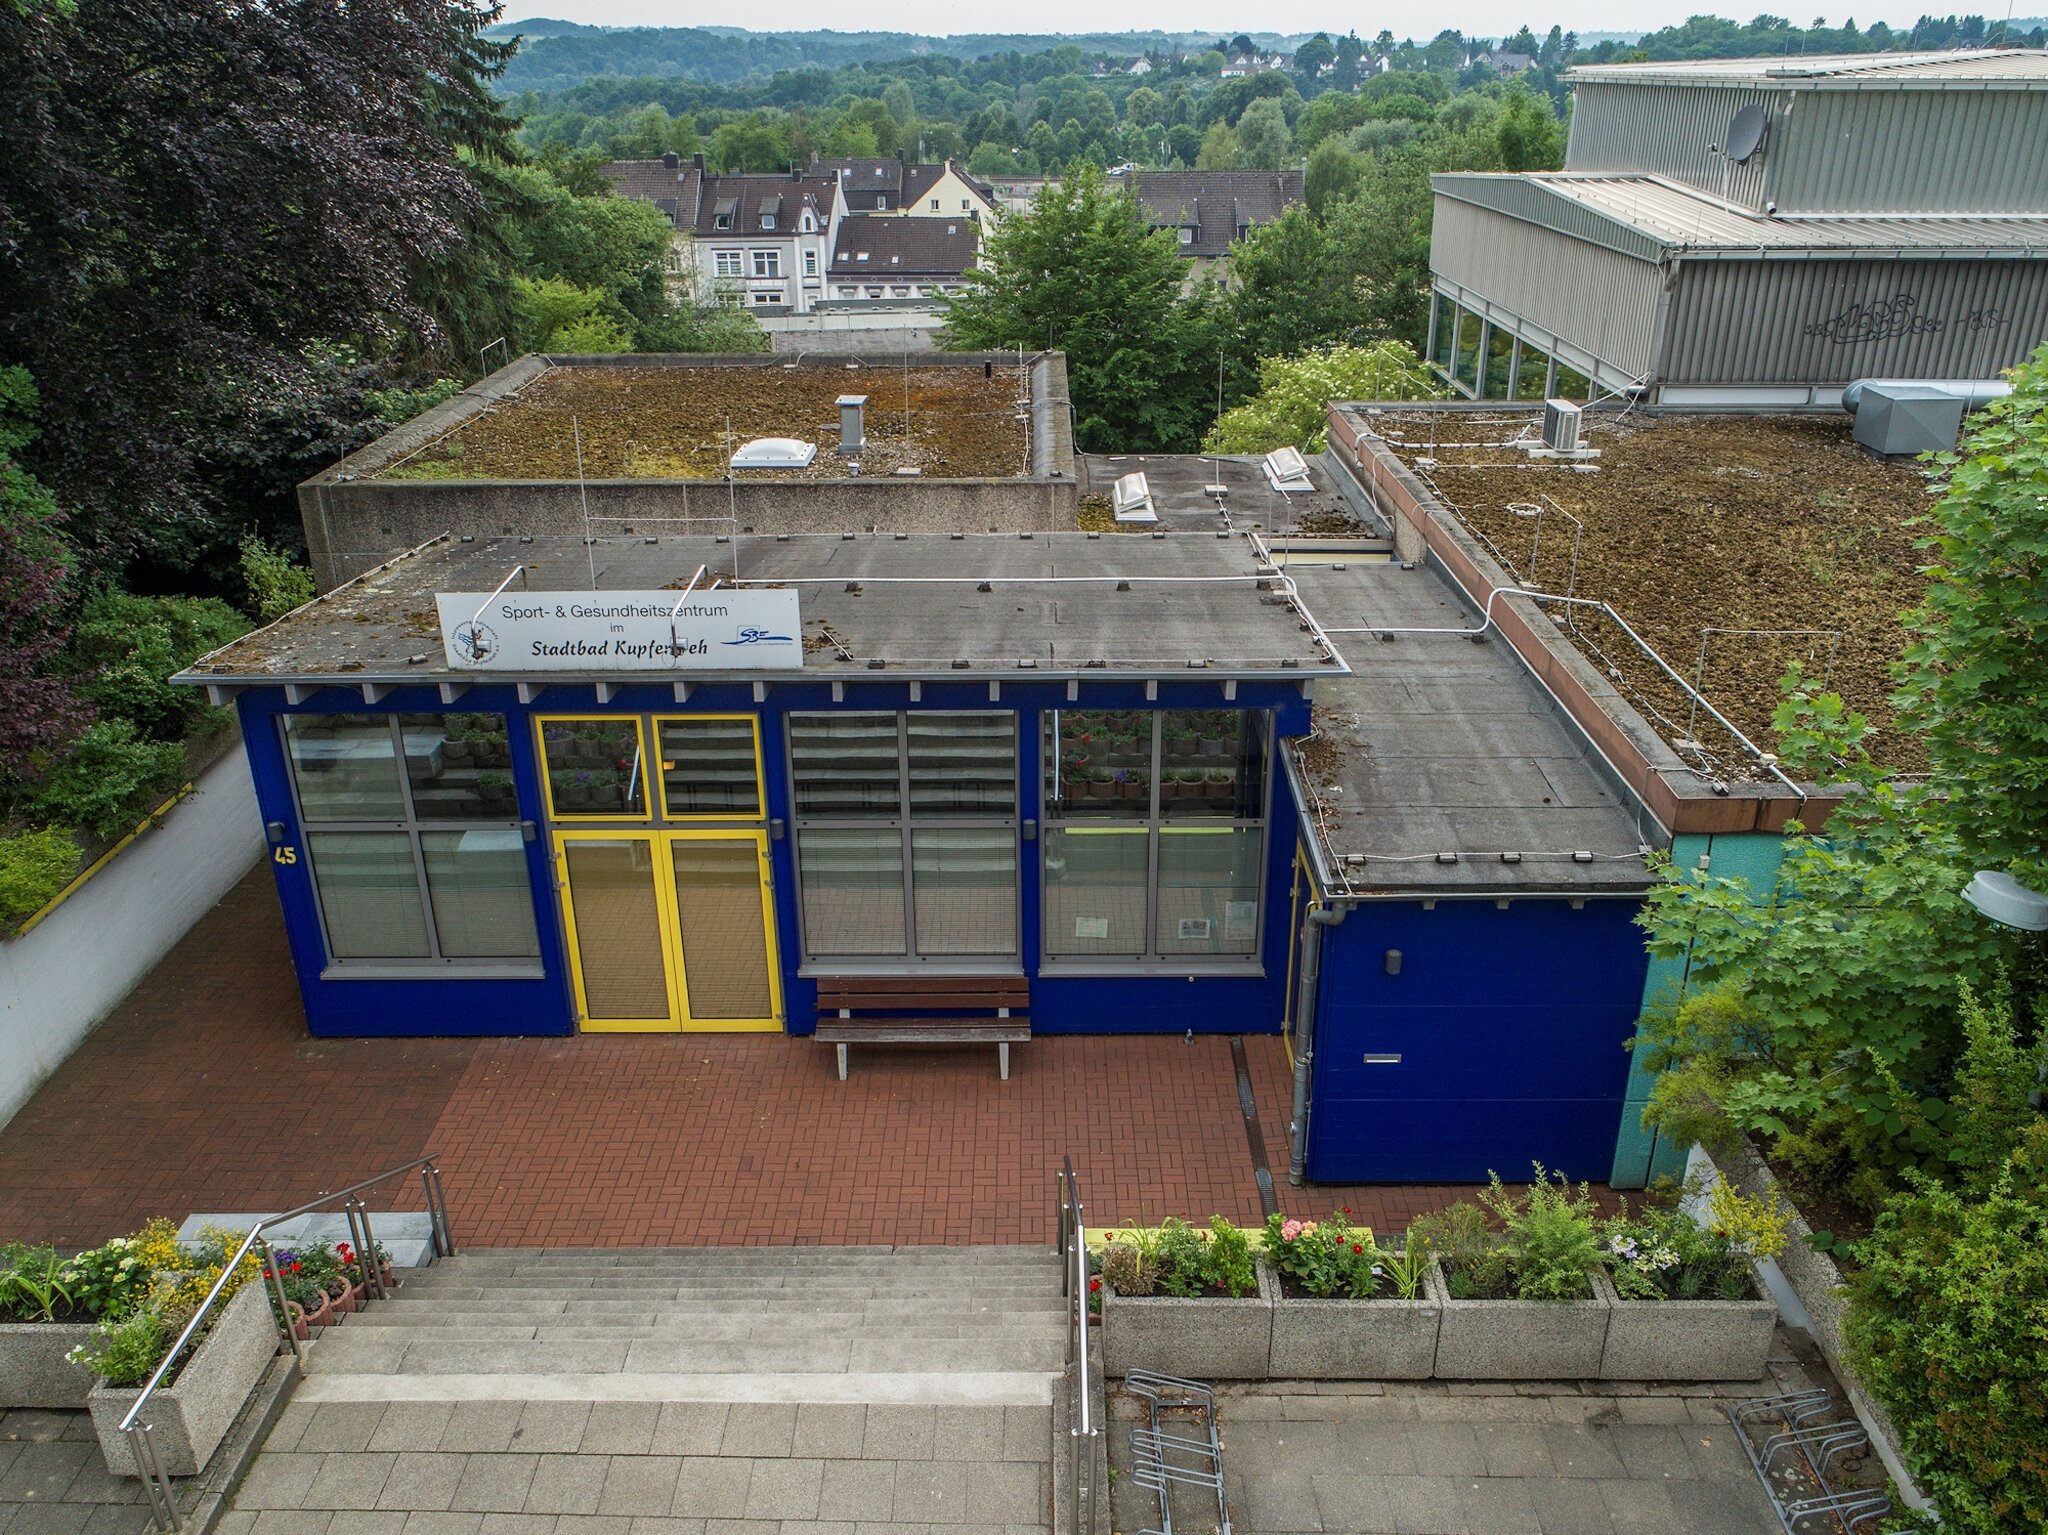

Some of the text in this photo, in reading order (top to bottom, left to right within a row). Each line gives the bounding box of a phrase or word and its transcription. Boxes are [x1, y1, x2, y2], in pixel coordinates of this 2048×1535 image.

[502, 604, 728, 621] Sport- & Gesundheitszentrum
[610, 623, 625, 633] im
[531, 639, 708, 659] Stadtbad Kupfereh
[275, 846, 297, 865] 45
